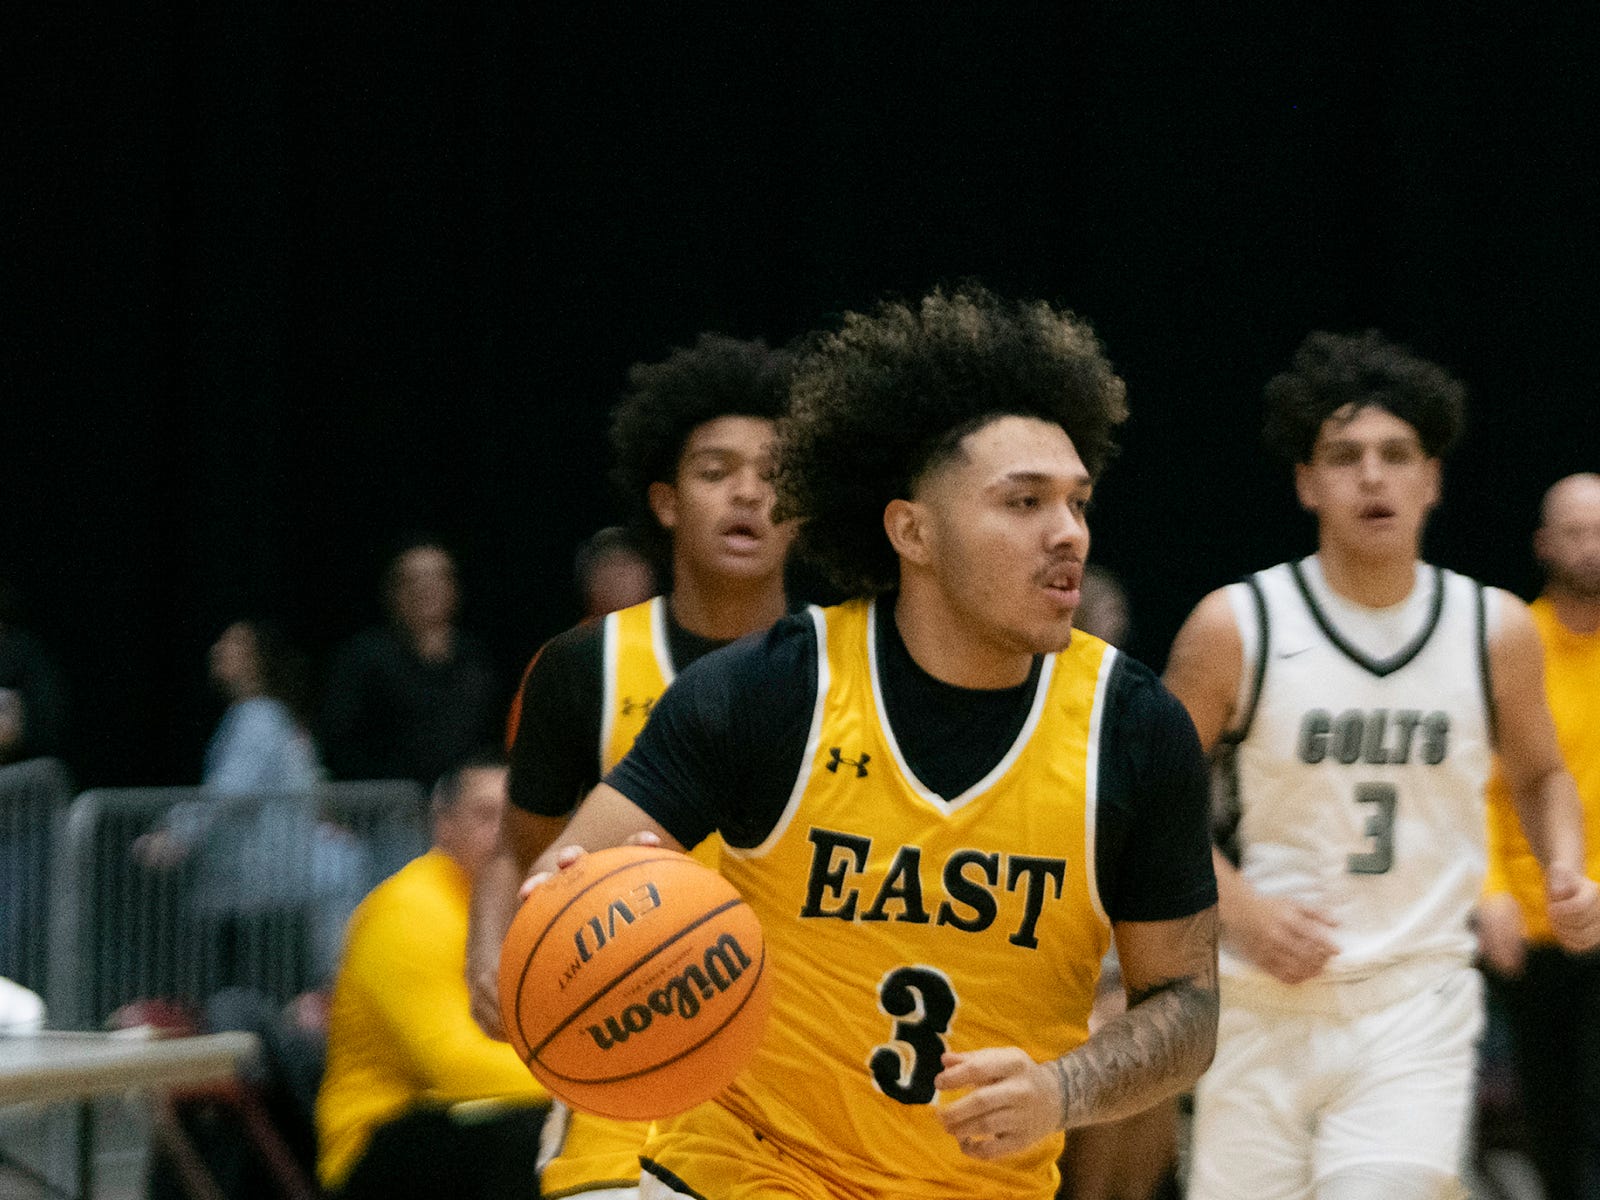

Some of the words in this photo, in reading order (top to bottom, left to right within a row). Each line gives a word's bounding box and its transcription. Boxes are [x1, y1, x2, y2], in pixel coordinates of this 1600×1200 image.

[1299, 708, 1449, 765] COLTS
[1348, 782, 1397, 874] 3
[574, 882, 661, 963] EVO
[799, 827, 1066, 950] EAST
[585, 932, 751, 1050] Wilson
[867, 964, 958, 1105] 3
